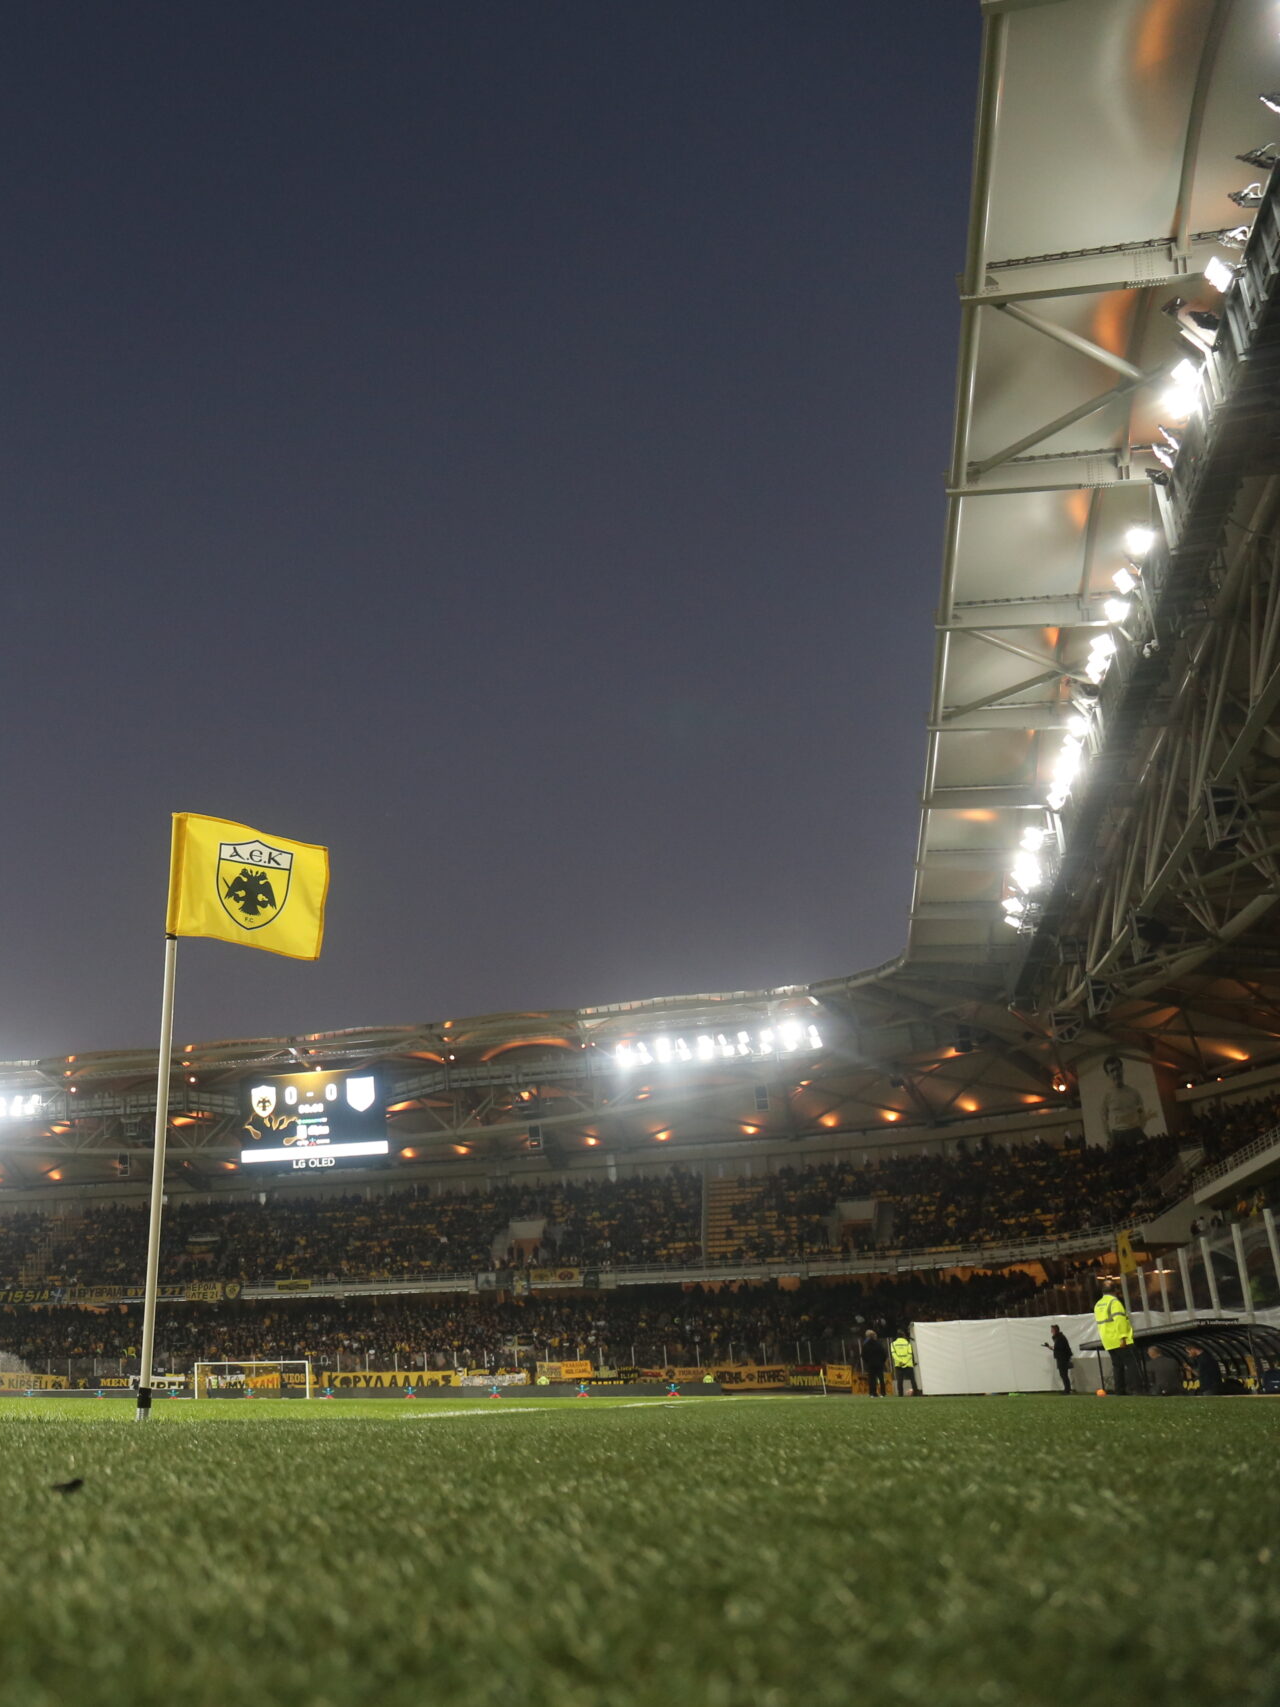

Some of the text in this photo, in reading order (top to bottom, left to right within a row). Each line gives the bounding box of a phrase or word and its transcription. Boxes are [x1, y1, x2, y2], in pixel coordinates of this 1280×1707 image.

[285, 1086, 297, 1105] 0
[325, 1083, 338, 1102] 0
[293, 1157, 336, 1169] LG OLED
